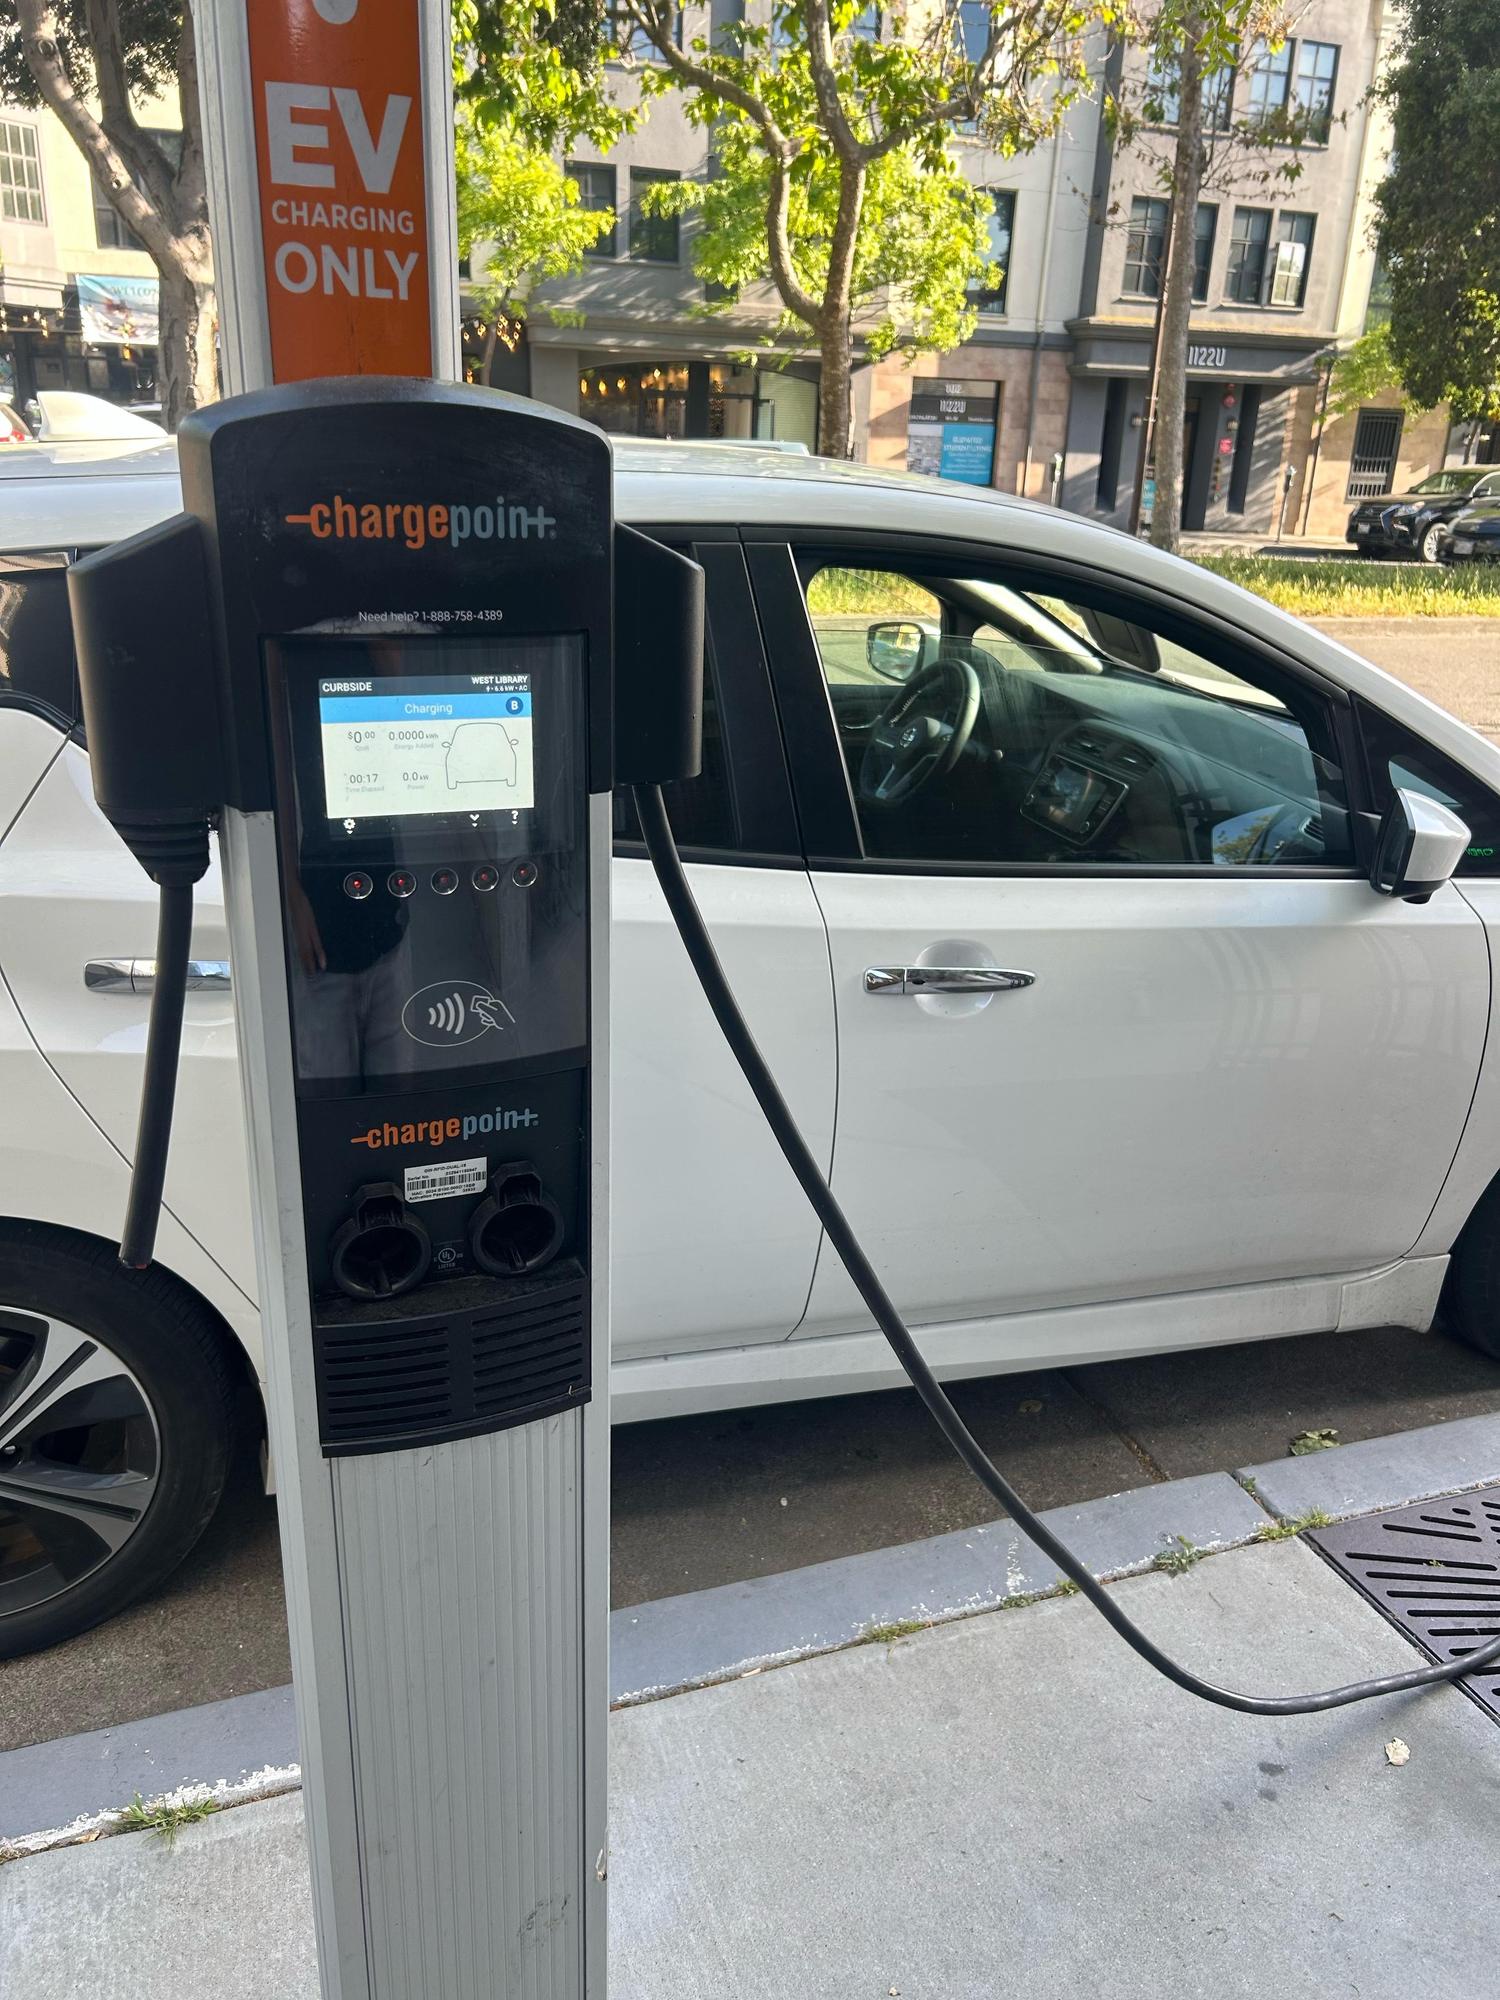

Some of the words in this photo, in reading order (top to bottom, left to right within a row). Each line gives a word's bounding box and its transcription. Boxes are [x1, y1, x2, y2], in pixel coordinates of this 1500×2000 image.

[265, 81, 412, 194] EV
[272, 199, 414, 235] CHARGING
[275, 241, 419, 300] ONLY
[1188, 346, 1226, 367] 1122U
[359, 611, 387, 622] Need
[390, 611, 419, 623] help?
[422, 610, 503, 622] 1-888-758-4389
[472, 676, 494, 684] WEST
[495, 676, 528, 684] LIBRARY
[322, 682, 372, 692] CURBSIDE
[404, 703, 453, 715] Charging
[511, 700, 519, 710] B
[388, 730, 425, 741] 0.0000
[349, 773, 378, 783] 00:17
[403, 771, 418, 781] 0.0
